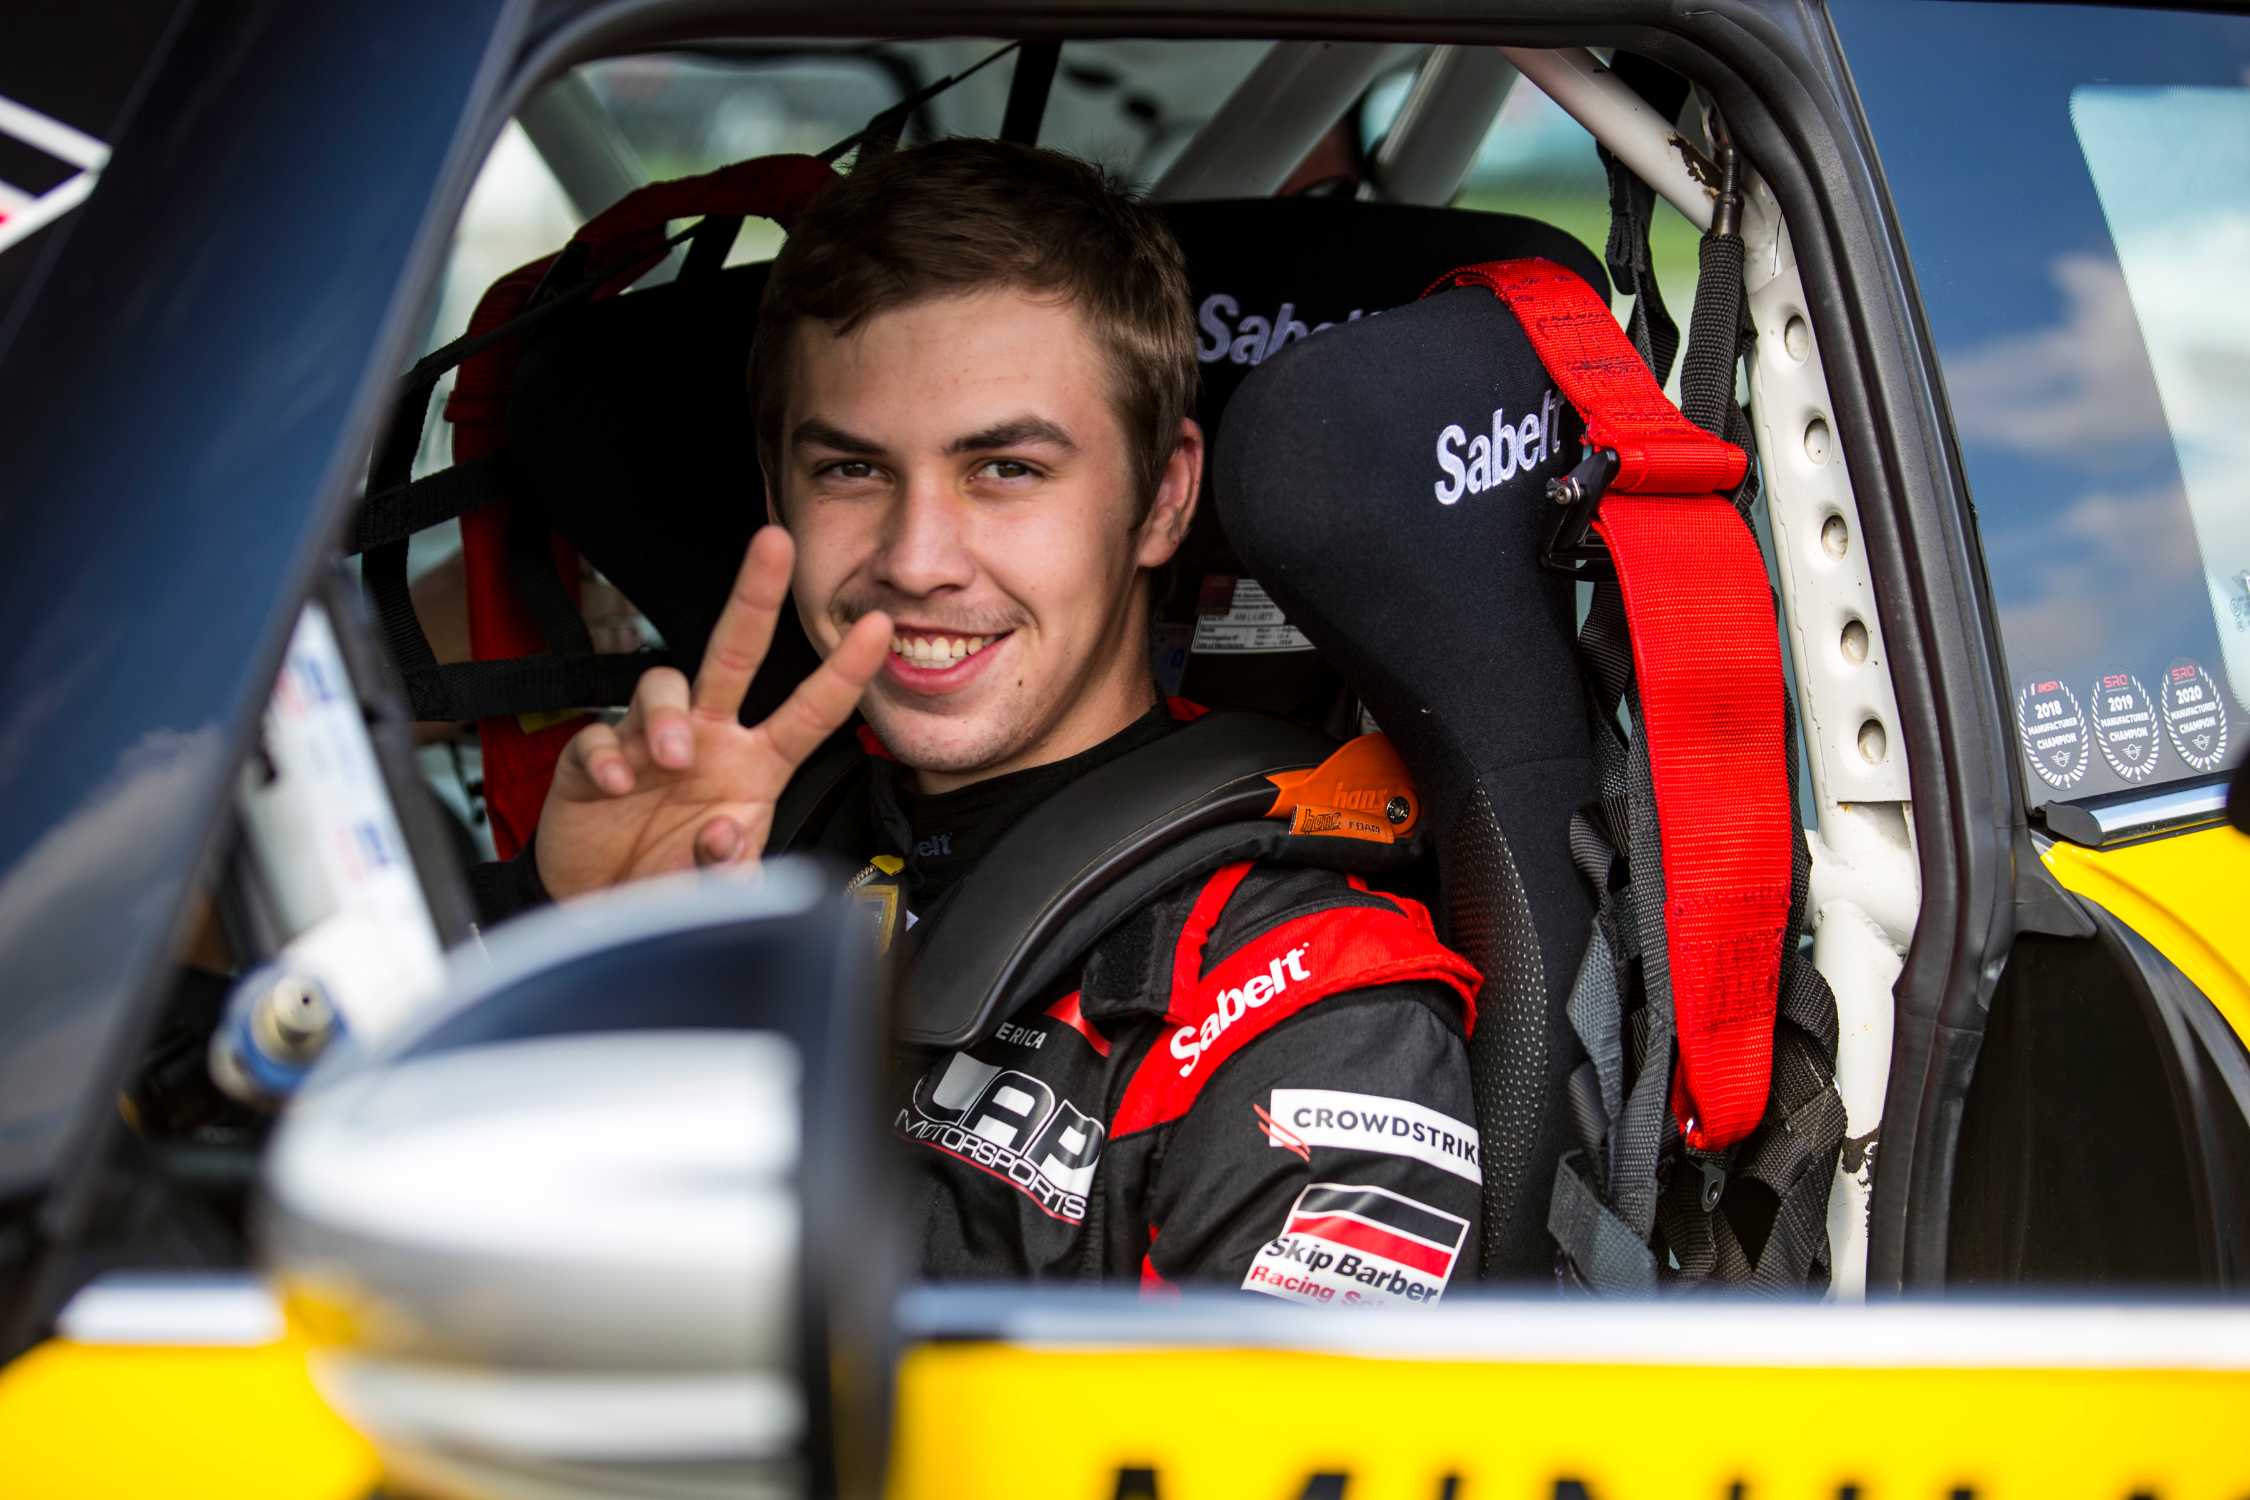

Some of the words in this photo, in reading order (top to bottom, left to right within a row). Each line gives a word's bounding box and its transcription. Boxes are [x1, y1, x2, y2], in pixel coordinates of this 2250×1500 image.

[1197, 293, 1366, 366] Sab
[1434, 390, 1563, 505] Sabelt
[2103, 674, 2129, 688] SRO
[2170, 665, 2197, 682] SRO
[2108, 694, 2134, 712] 2019
[2175, 685, 2203, 705] 2020
[2035, 700, 2063, 719] 2018
[2170, 701, 2217, 720] MANUFACTURER
[2028, 717, 2078, 736] MANUFACTURER
[2100, 711, 2150, 728] MANUFACTURER
[2179, 717, 2217, 735] CHAMPION
[2036, 732, 2078, 750] CHAMPION
[2109, 727, 2149, 743] CHAMPION
[1169, 948, 1311, 1078] Sabelt
[1293, 1107, 1481, 1168] CROWDSTRIK
[894, 1108, 1087, 1220] MOTORSPORTS
[1265, 1237, 1333, 1272] Skip
[1335, 1253, 1439, 1305] Barber
[1250, 1264, 1336, 1305] Racing
